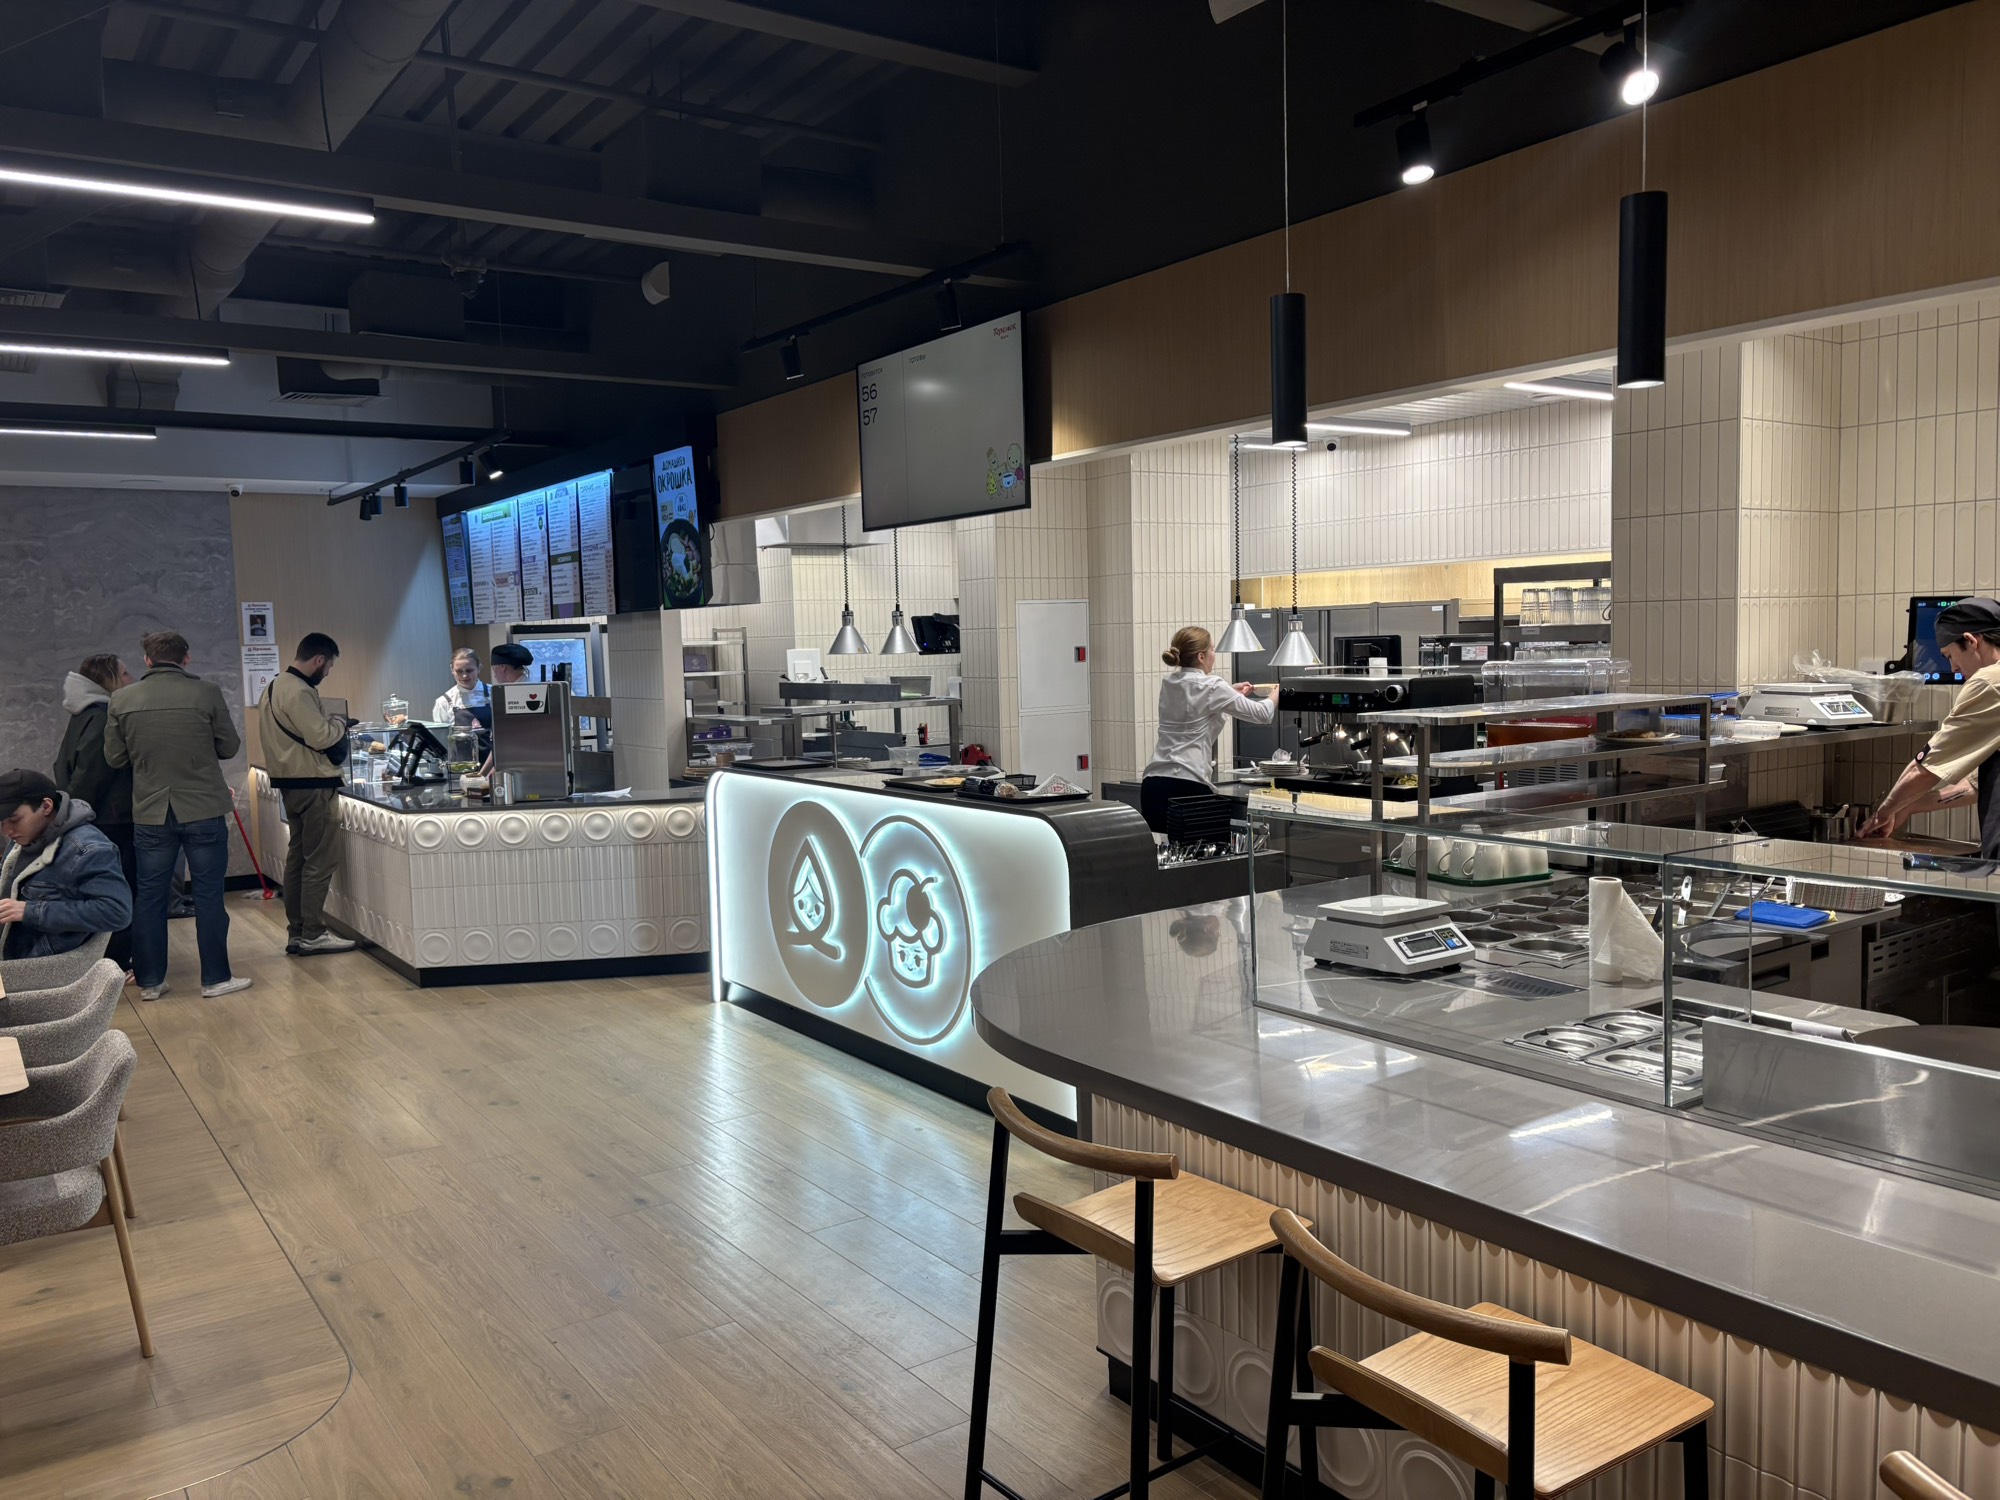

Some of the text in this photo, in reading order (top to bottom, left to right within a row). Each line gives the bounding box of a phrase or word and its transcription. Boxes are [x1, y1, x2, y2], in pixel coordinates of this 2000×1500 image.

[861, 383, 878, 402] 56
[862, 407, 878, 426] 57
[657, 466, 693, 494] ОКРОШКА
